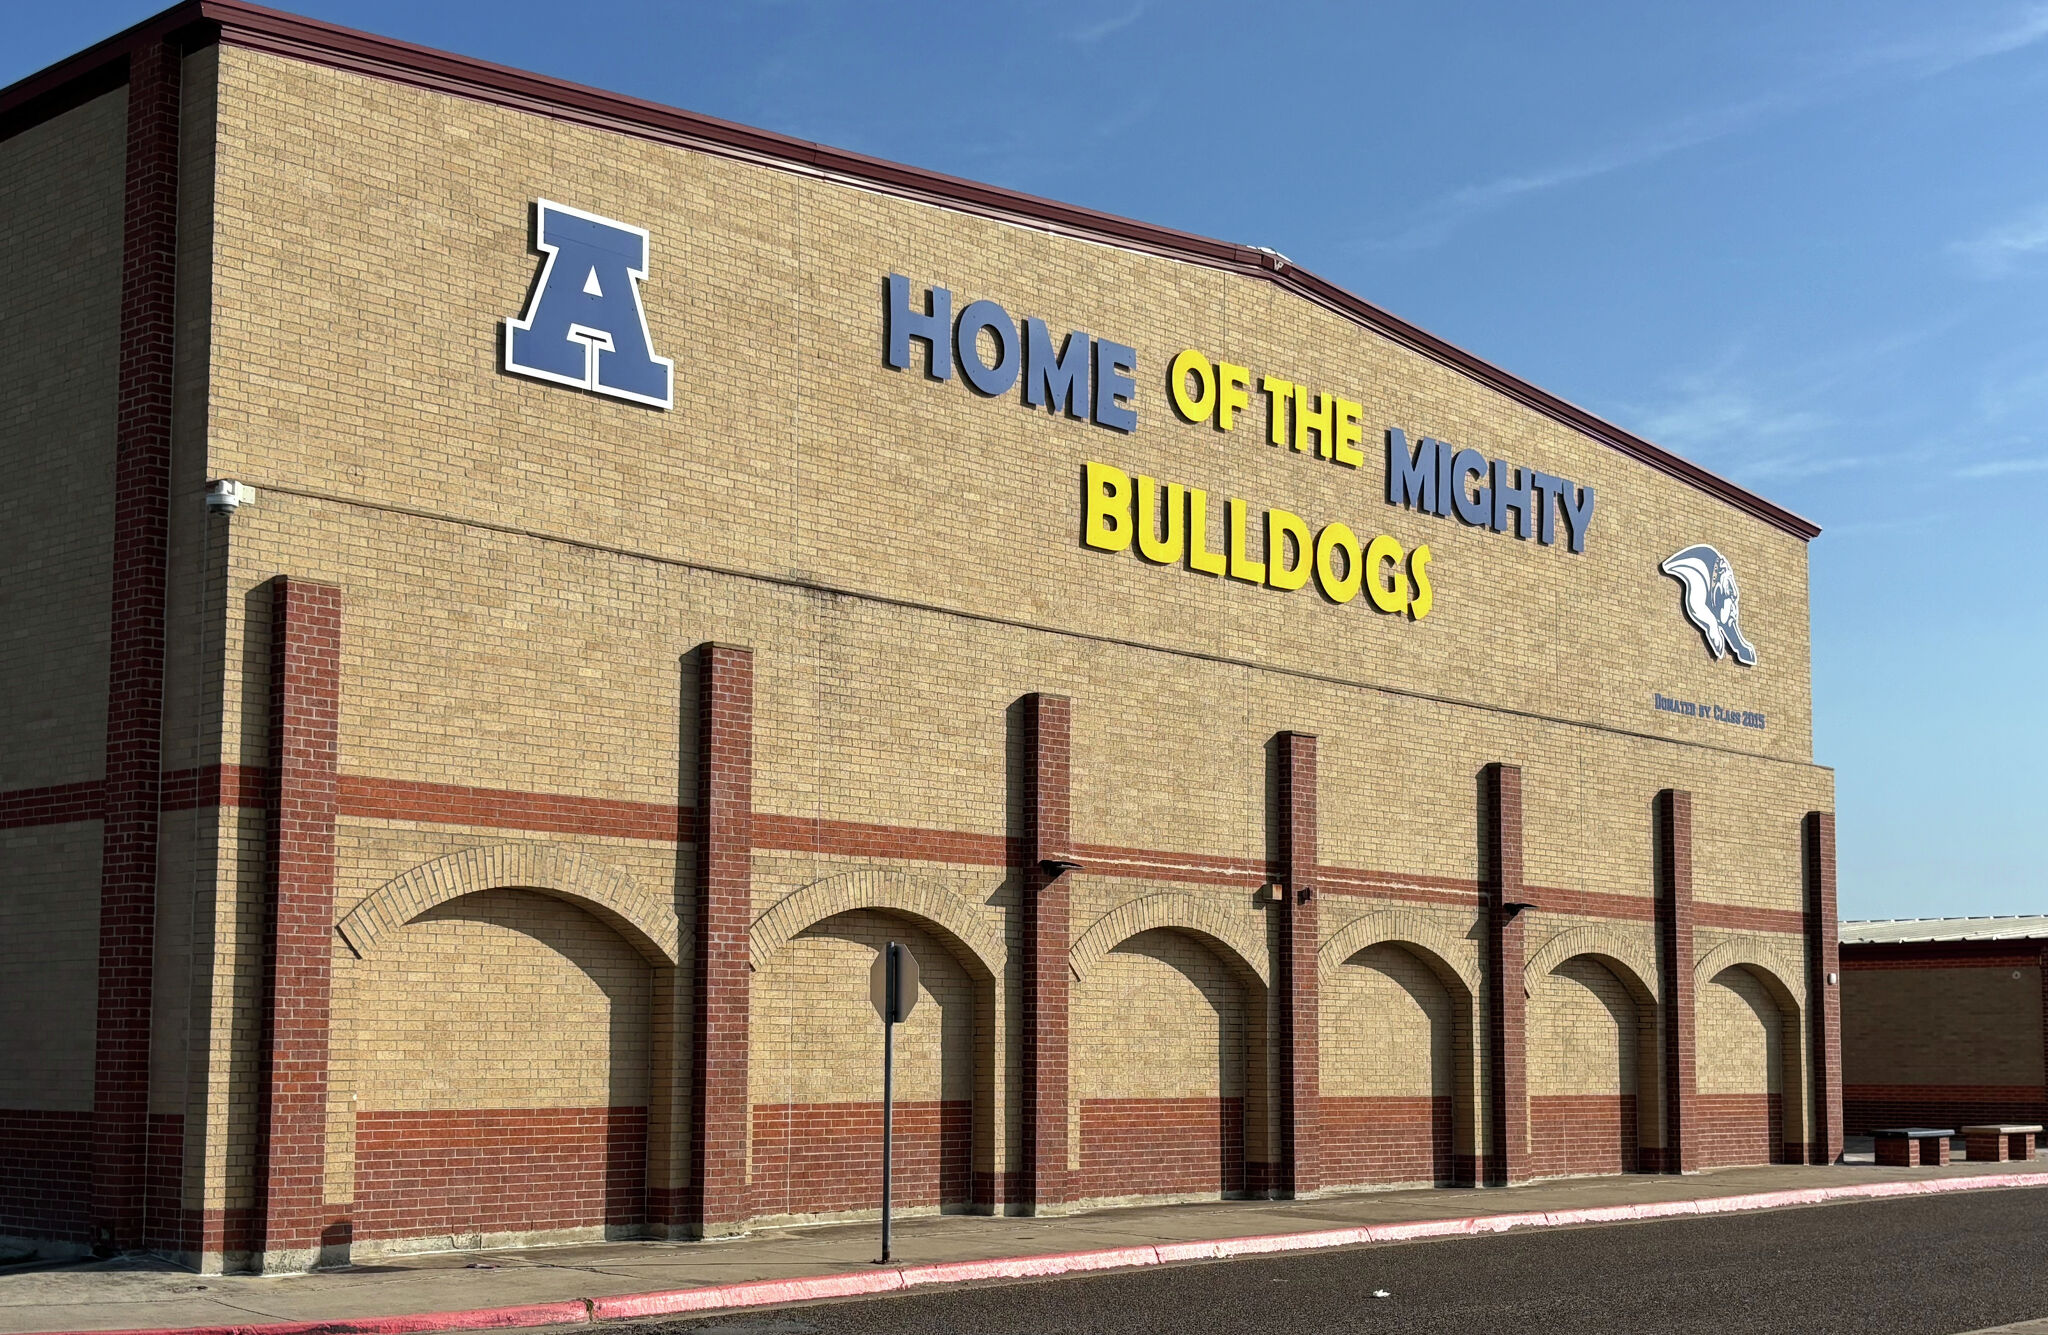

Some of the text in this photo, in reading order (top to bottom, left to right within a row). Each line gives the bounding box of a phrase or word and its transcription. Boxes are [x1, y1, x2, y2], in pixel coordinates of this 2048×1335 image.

[505, 197, 674, 410] A
[888, 272, 1595, 553] HOME OF THE MIGHTY
[1086, 460, 1433, 620] BULLDOGS
[1742, 710, 1766, 730] 2015
